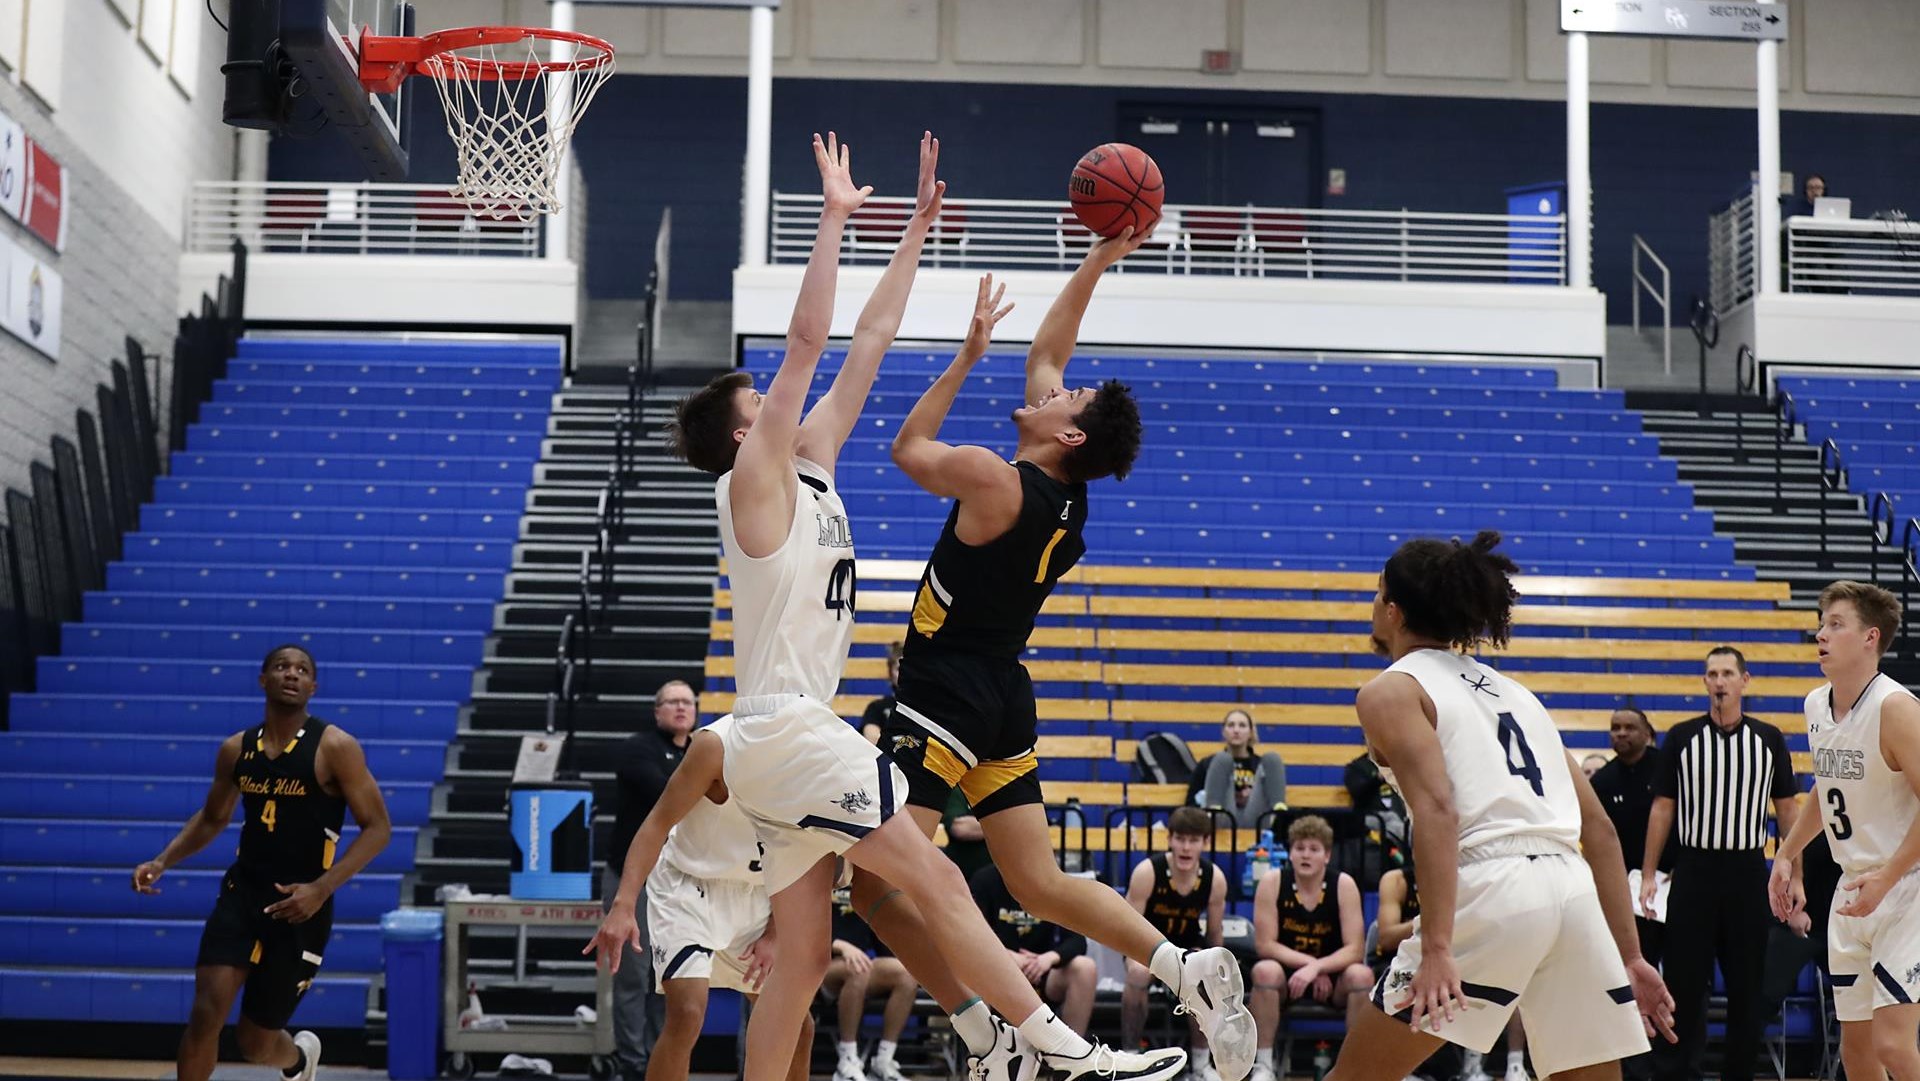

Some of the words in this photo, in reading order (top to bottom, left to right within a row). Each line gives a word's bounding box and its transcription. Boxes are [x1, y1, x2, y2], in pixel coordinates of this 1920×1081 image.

[1709, 5, 1761, 18] SECTION
[1033, 528, 1068, 583] 1
[825, 558, 857, 621] 40
[1497, 711, 1544, 797] 4
[239, 775, 270, 794] Black
[273, 777, 307, 796] Hills
[260, 799, 277, 832] 4
[1827, 787, 1852, 841] 3
